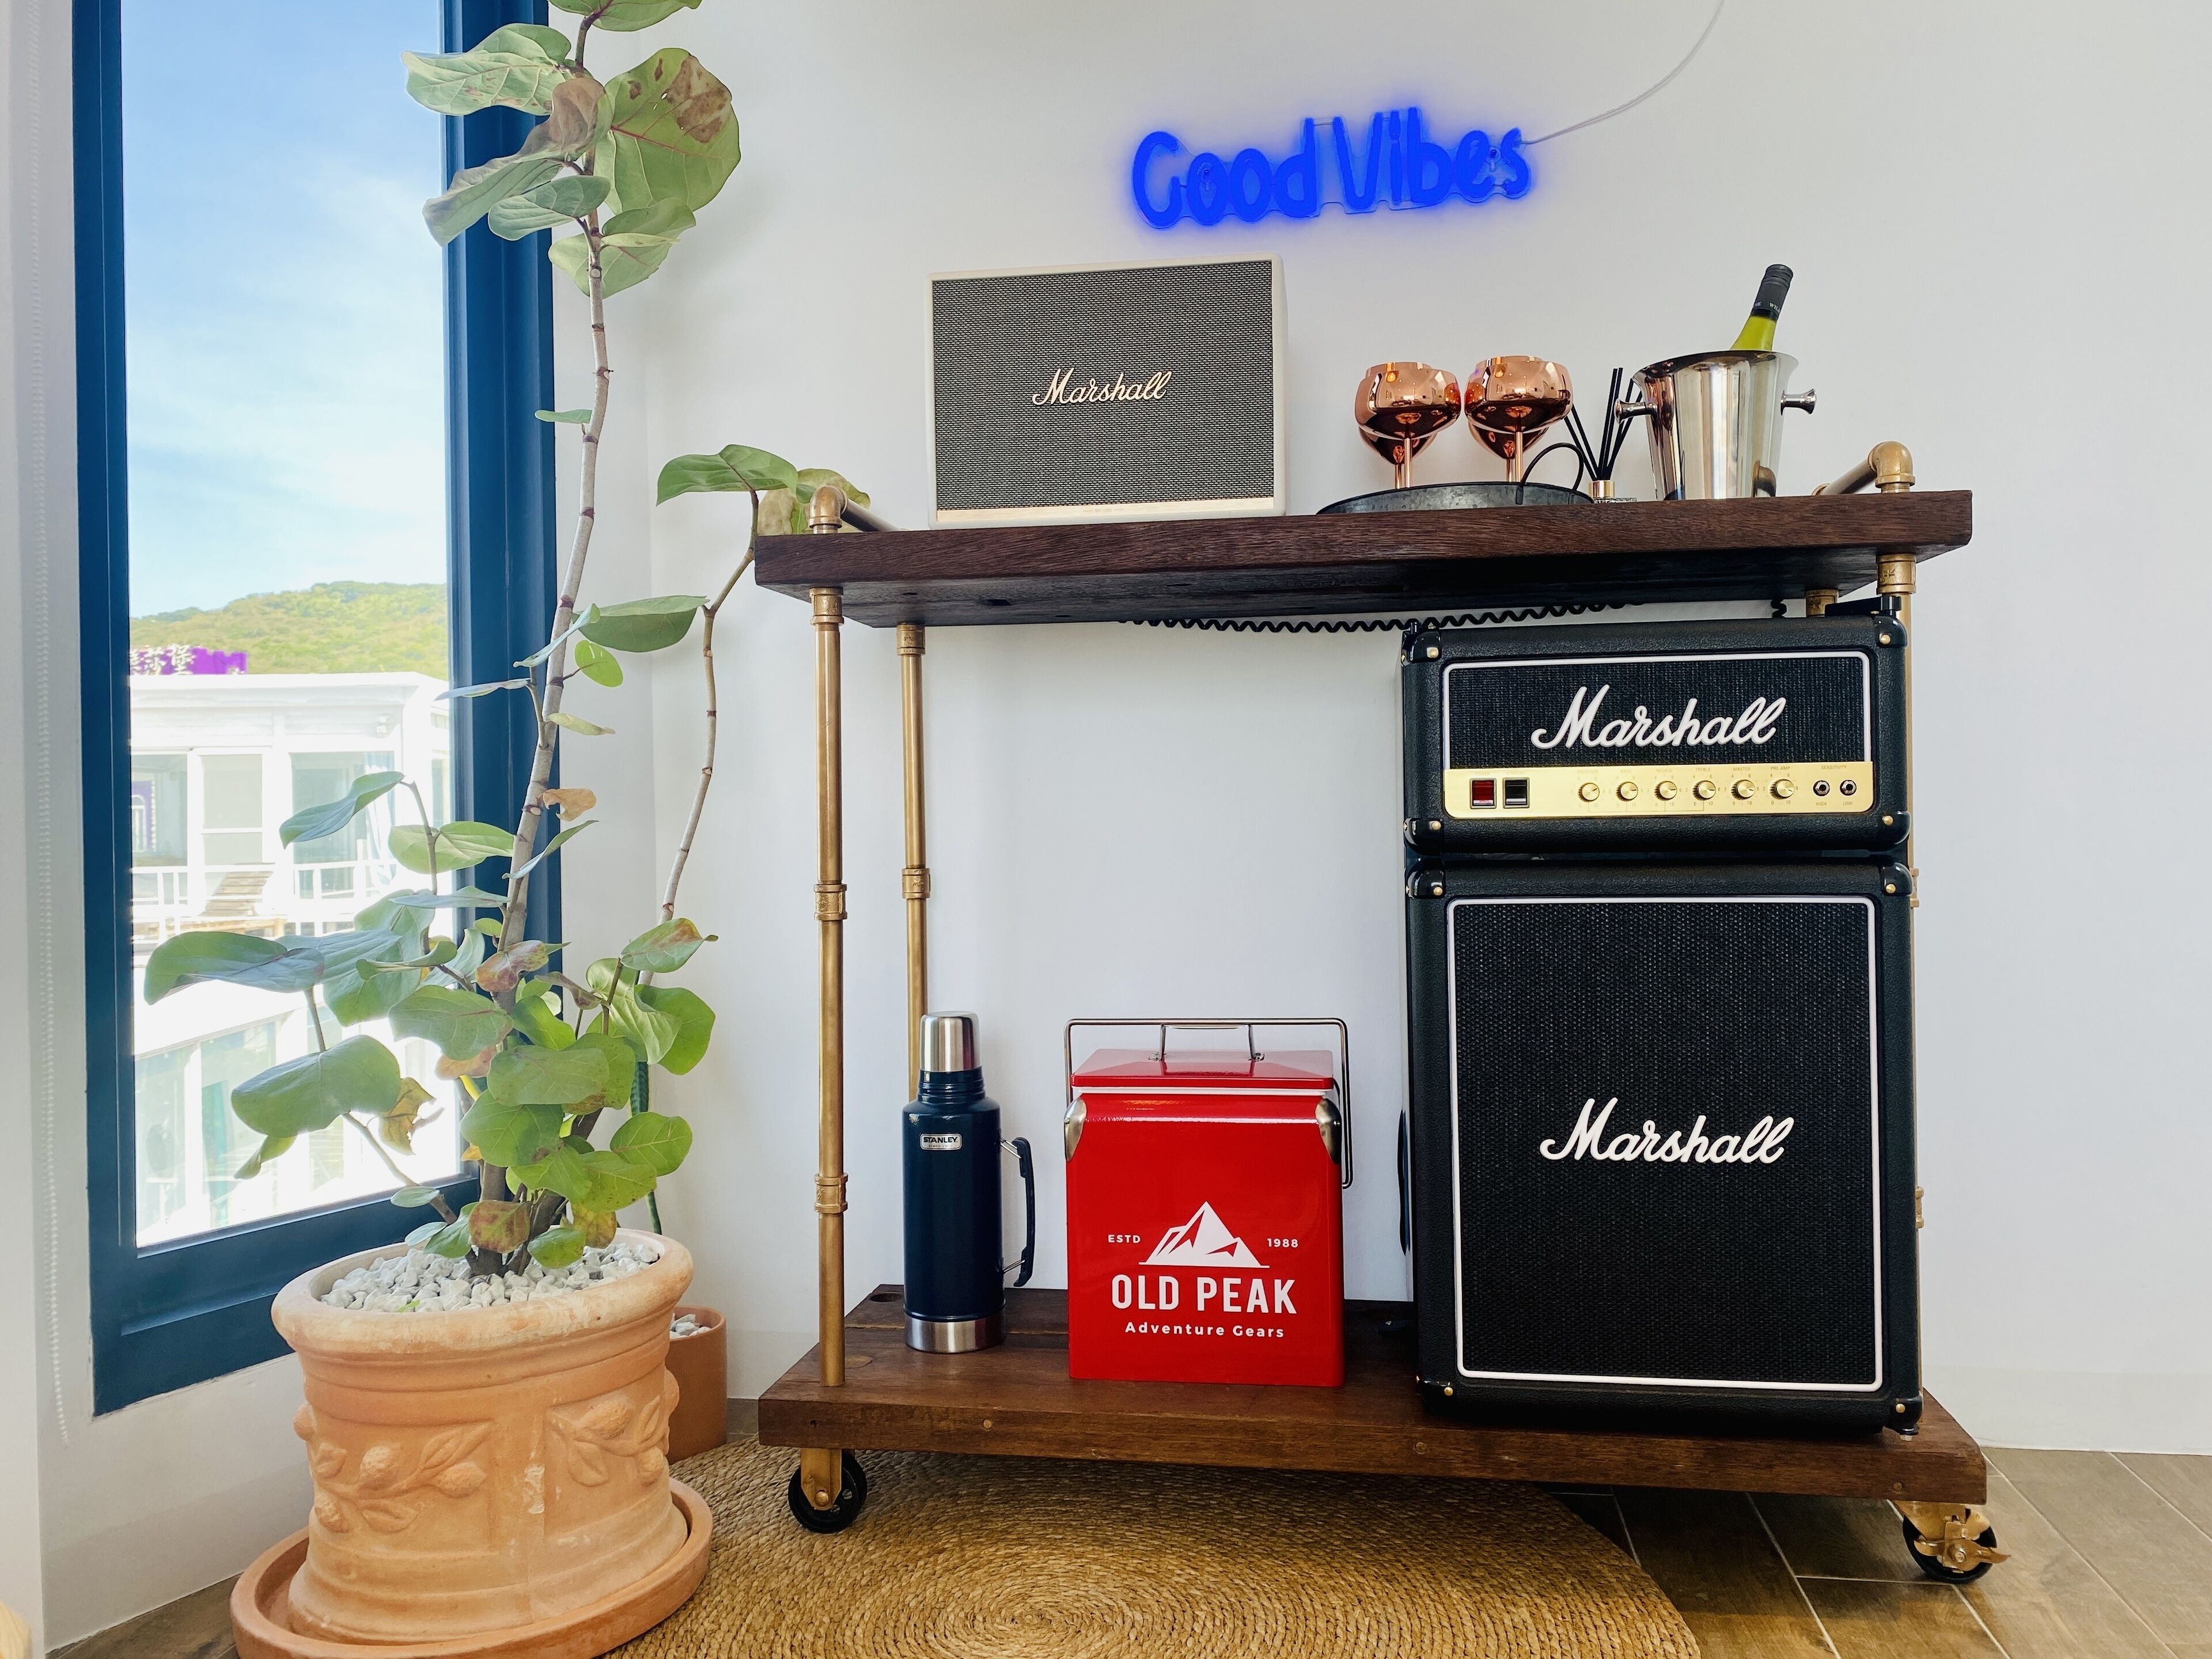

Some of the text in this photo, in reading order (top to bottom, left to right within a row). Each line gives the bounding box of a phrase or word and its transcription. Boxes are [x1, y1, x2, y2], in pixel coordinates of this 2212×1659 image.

[1132, 107, 1530, 228] Good Vibes
[1032, 367, 1172, 405] Marshall
[1531, 684, 1786, 749] Marshall
[1539, 1097, 1795, 1164] Marshall
[1108, 1234, 1298, 1248] ESTD 1988
[1112, 1274, 1297, 1314] OLD PEAK
[1125, 1321, 1284, 1338] Adventure Gears
